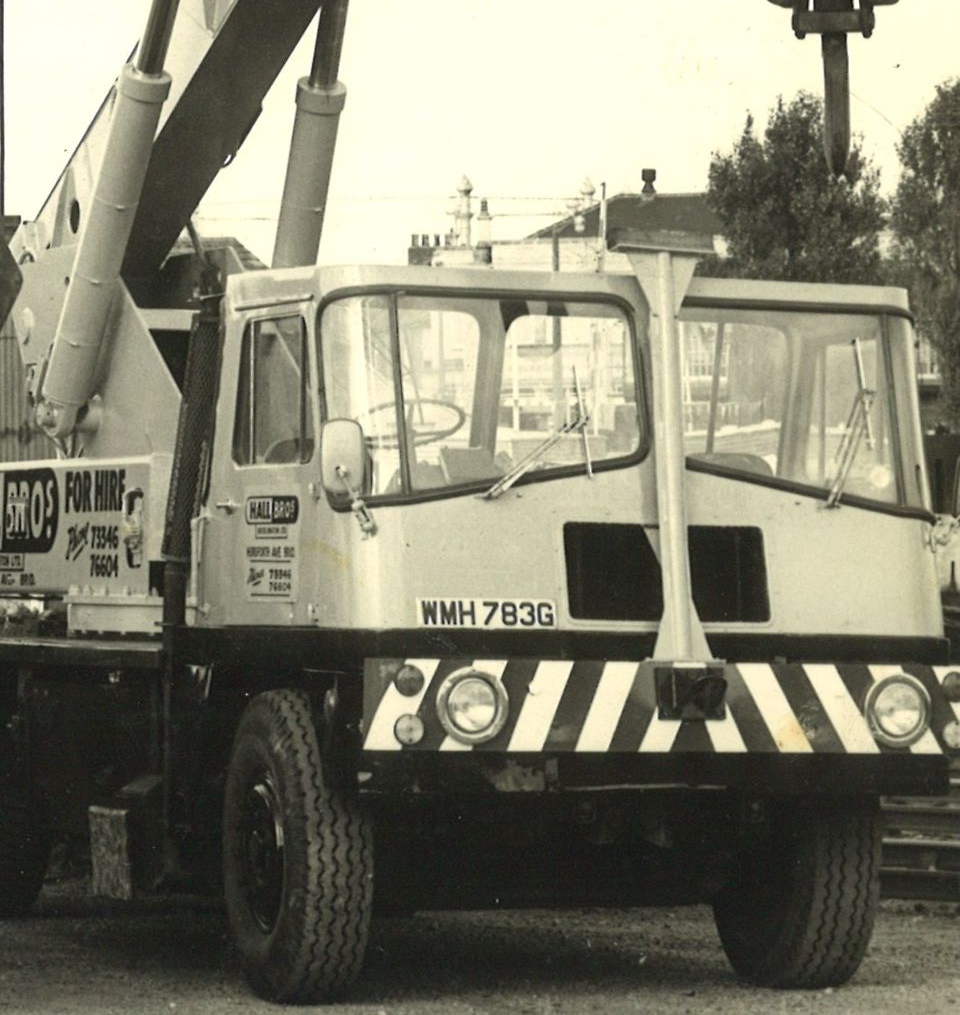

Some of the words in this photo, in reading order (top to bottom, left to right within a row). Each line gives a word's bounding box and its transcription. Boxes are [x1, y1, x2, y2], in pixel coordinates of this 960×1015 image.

[65, 471, 92, 514] FOR
[249, 501, 271, 520] HALL
[90, 525, 119, 550] 73346
[90, 553, 119, 578] 76604
[422, 600, 476, 626] WMH
[482, 602, 555, 626] 783G
